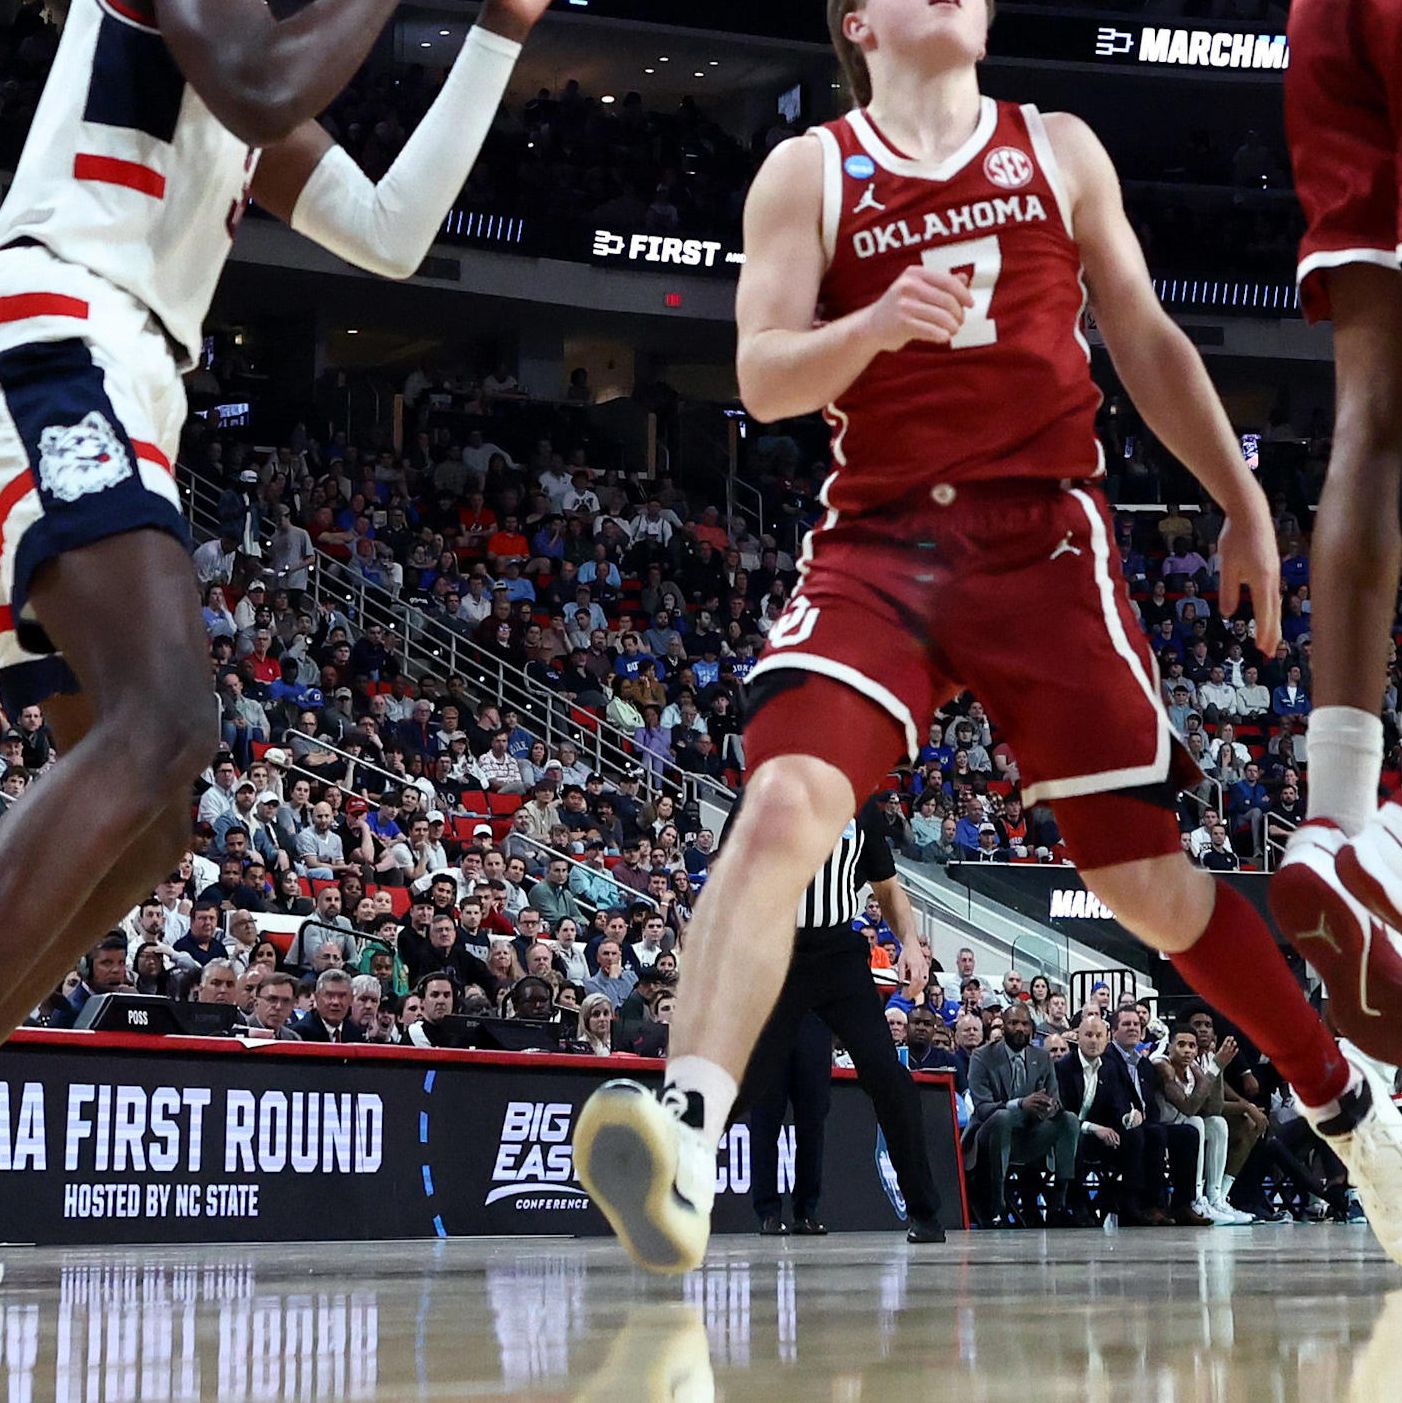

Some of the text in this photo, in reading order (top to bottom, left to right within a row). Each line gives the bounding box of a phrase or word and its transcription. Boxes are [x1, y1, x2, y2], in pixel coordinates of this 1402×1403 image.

[987, 152, 1032, 184] SEC
[852, 194, 1047, 260] OKLAHOMA
[628, 234, 722, 269] FIRST
[920, 235, 1003, 350] 7
[128, 1009, 149, 1025] POSS
[64, 1083, 211, 1173] FIRST
[225, 1089, 384, 1174] ROUND
[501, 1102, 573, 1142] BIG
[491, 1144, 581, 1182] EAS
[64, 1183, 259, 1218] HOSTED BY NC STATE
[515, 1197, 589, 1210] CONFERENCE
